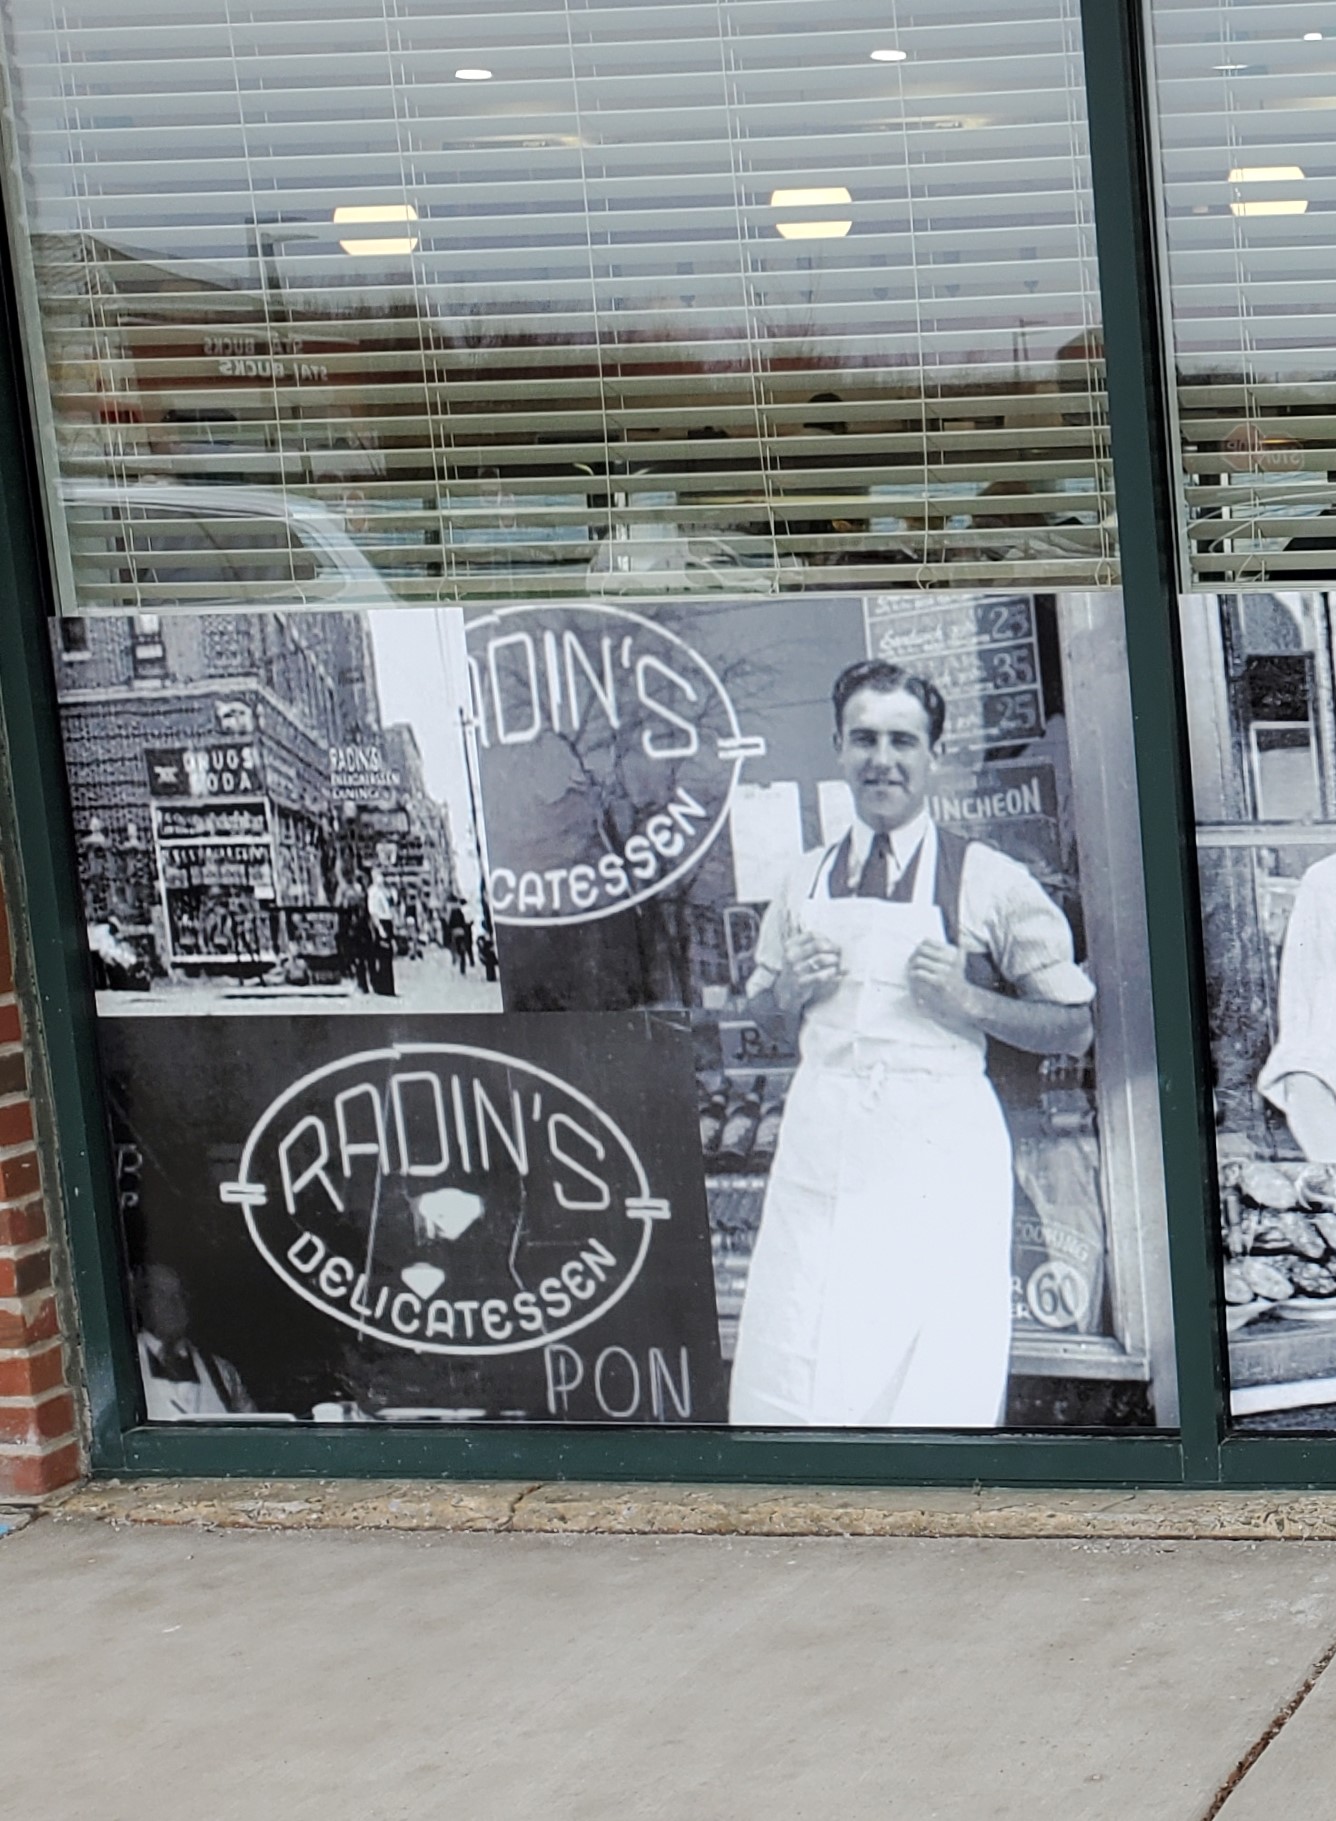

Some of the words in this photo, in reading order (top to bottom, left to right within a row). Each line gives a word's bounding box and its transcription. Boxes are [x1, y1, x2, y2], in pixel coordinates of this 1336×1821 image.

[278, 1070, 612, 1216] RADIN'S
[287, 1230, 617, 1340] DELICATESSEN
[543, 1344, 691, 1419] PON
